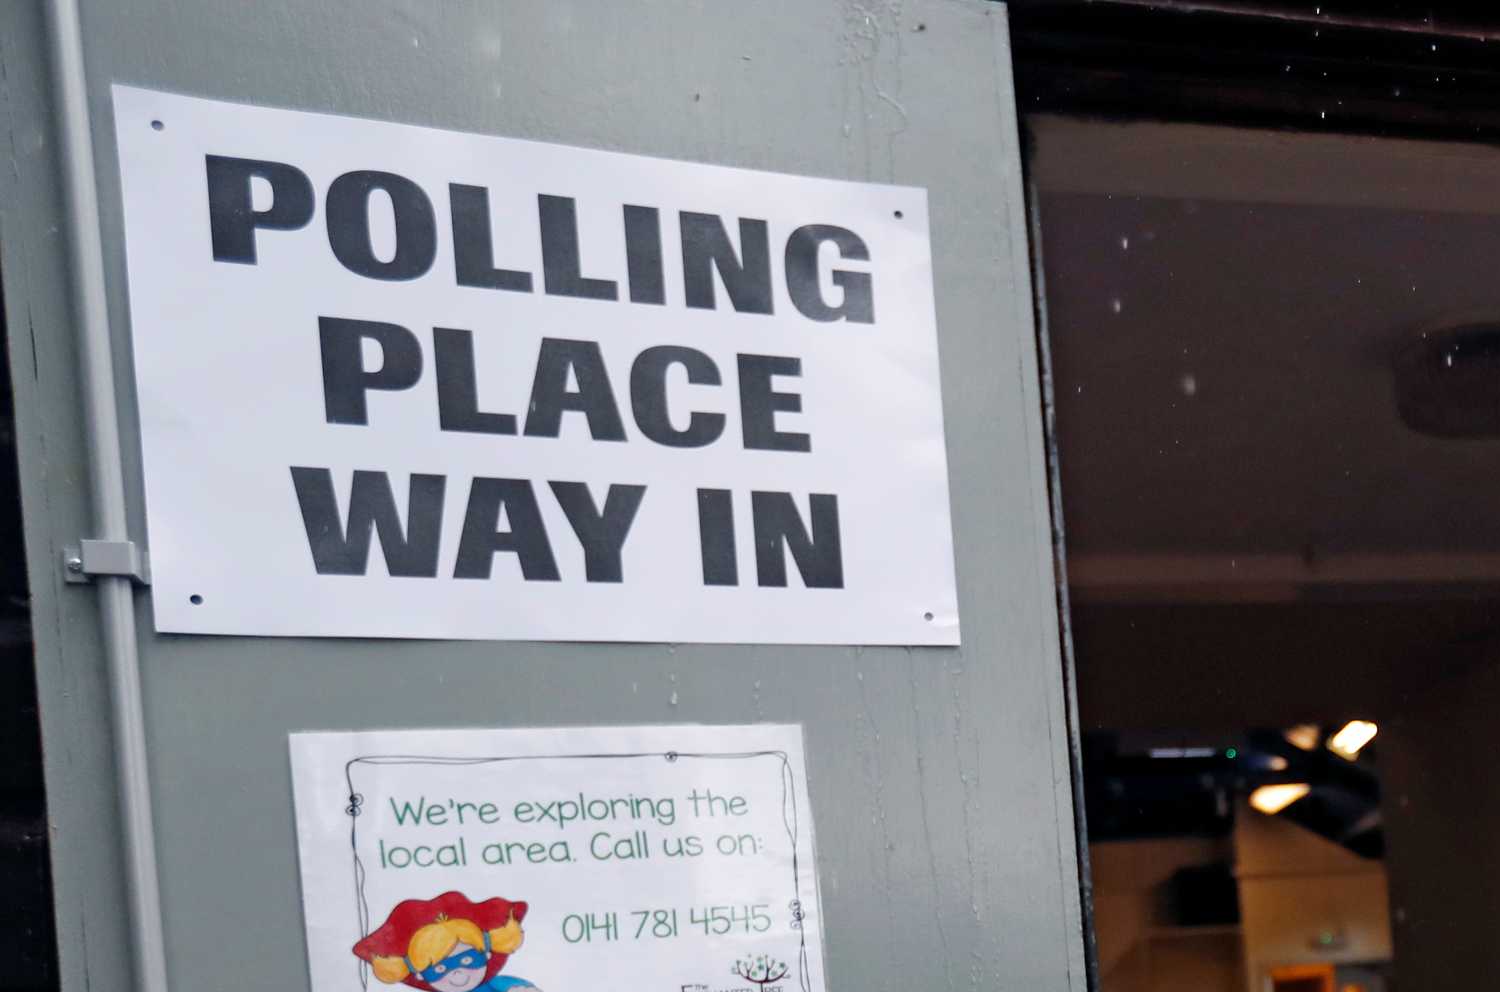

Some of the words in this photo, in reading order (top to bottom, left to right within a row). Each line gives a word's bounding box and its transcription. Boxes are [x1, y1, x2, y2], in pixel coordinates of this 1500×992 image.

[205, 154, 875, 325] POLLING
[317, 316, 812, 452] PLACE
[289, 465, 647, 583] WAY
[697, 488, 845, 589] IN
[379, 836, 467, 869] local
[481, 841, 577, 865] area.
[590, 830, 650, 860] Call
[663, 835, 703, 857] us
[716, 832, 764, 857] on:
[389, 796, 500, 826] We're
[513, 792, 676, 829] exploring
[688, 788, 749, 818] the
[562, 911, 618, 943] 0141
[631, 908, 678, 939] 781
[690, 904, 772, 936] 4545
